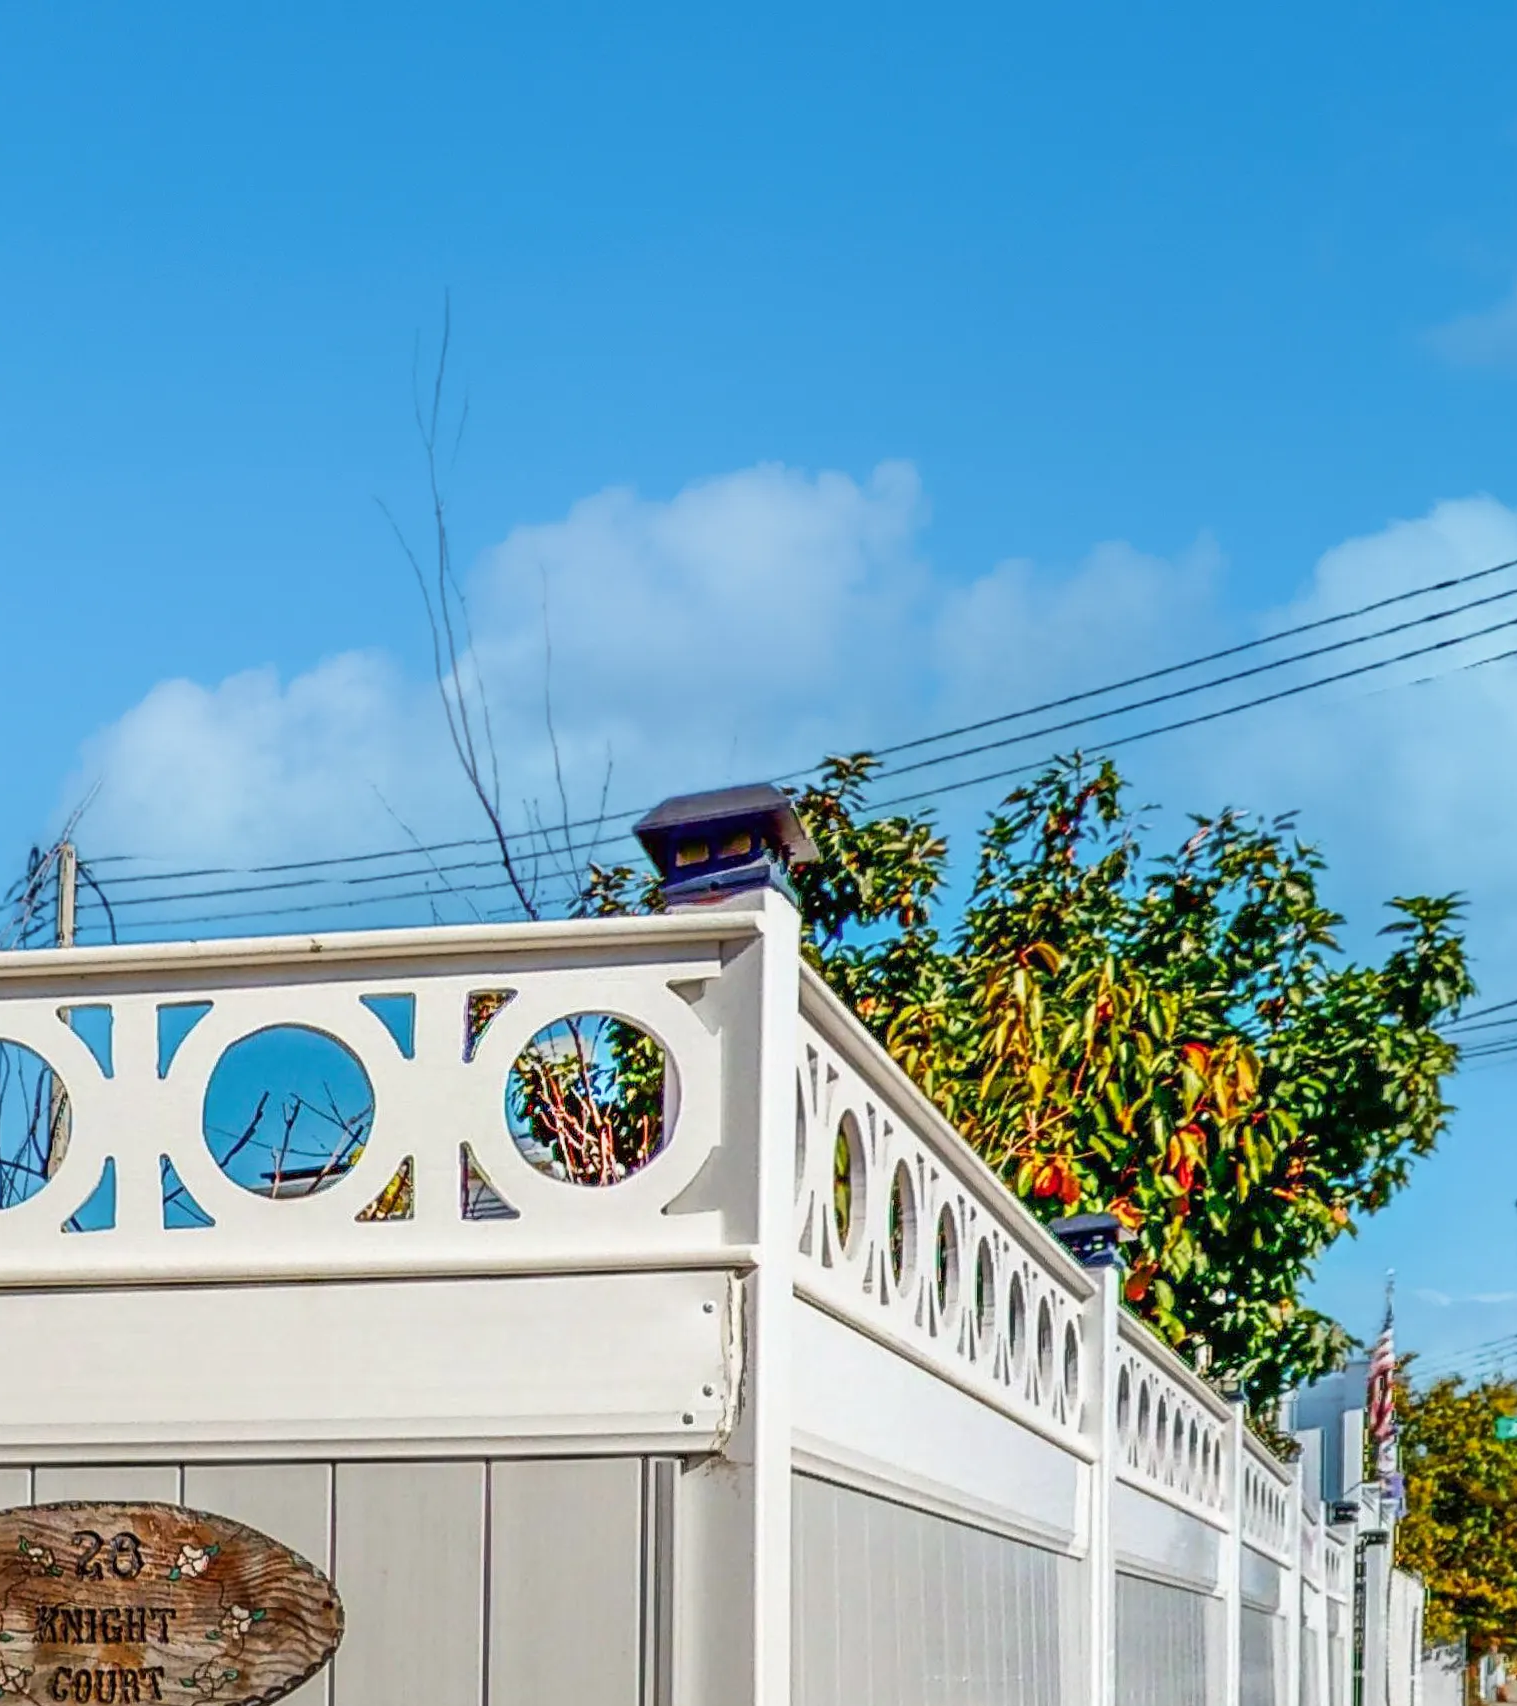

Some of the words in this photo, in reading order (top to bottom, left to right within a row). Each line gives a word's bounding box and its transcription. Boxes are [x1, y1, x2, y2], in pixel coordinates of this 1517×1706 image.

[71, 1529, 145, 1581] 28
[33, 1604, 176, 1644] KNIGHT
[51, 1665, 165, 1704] COURT
